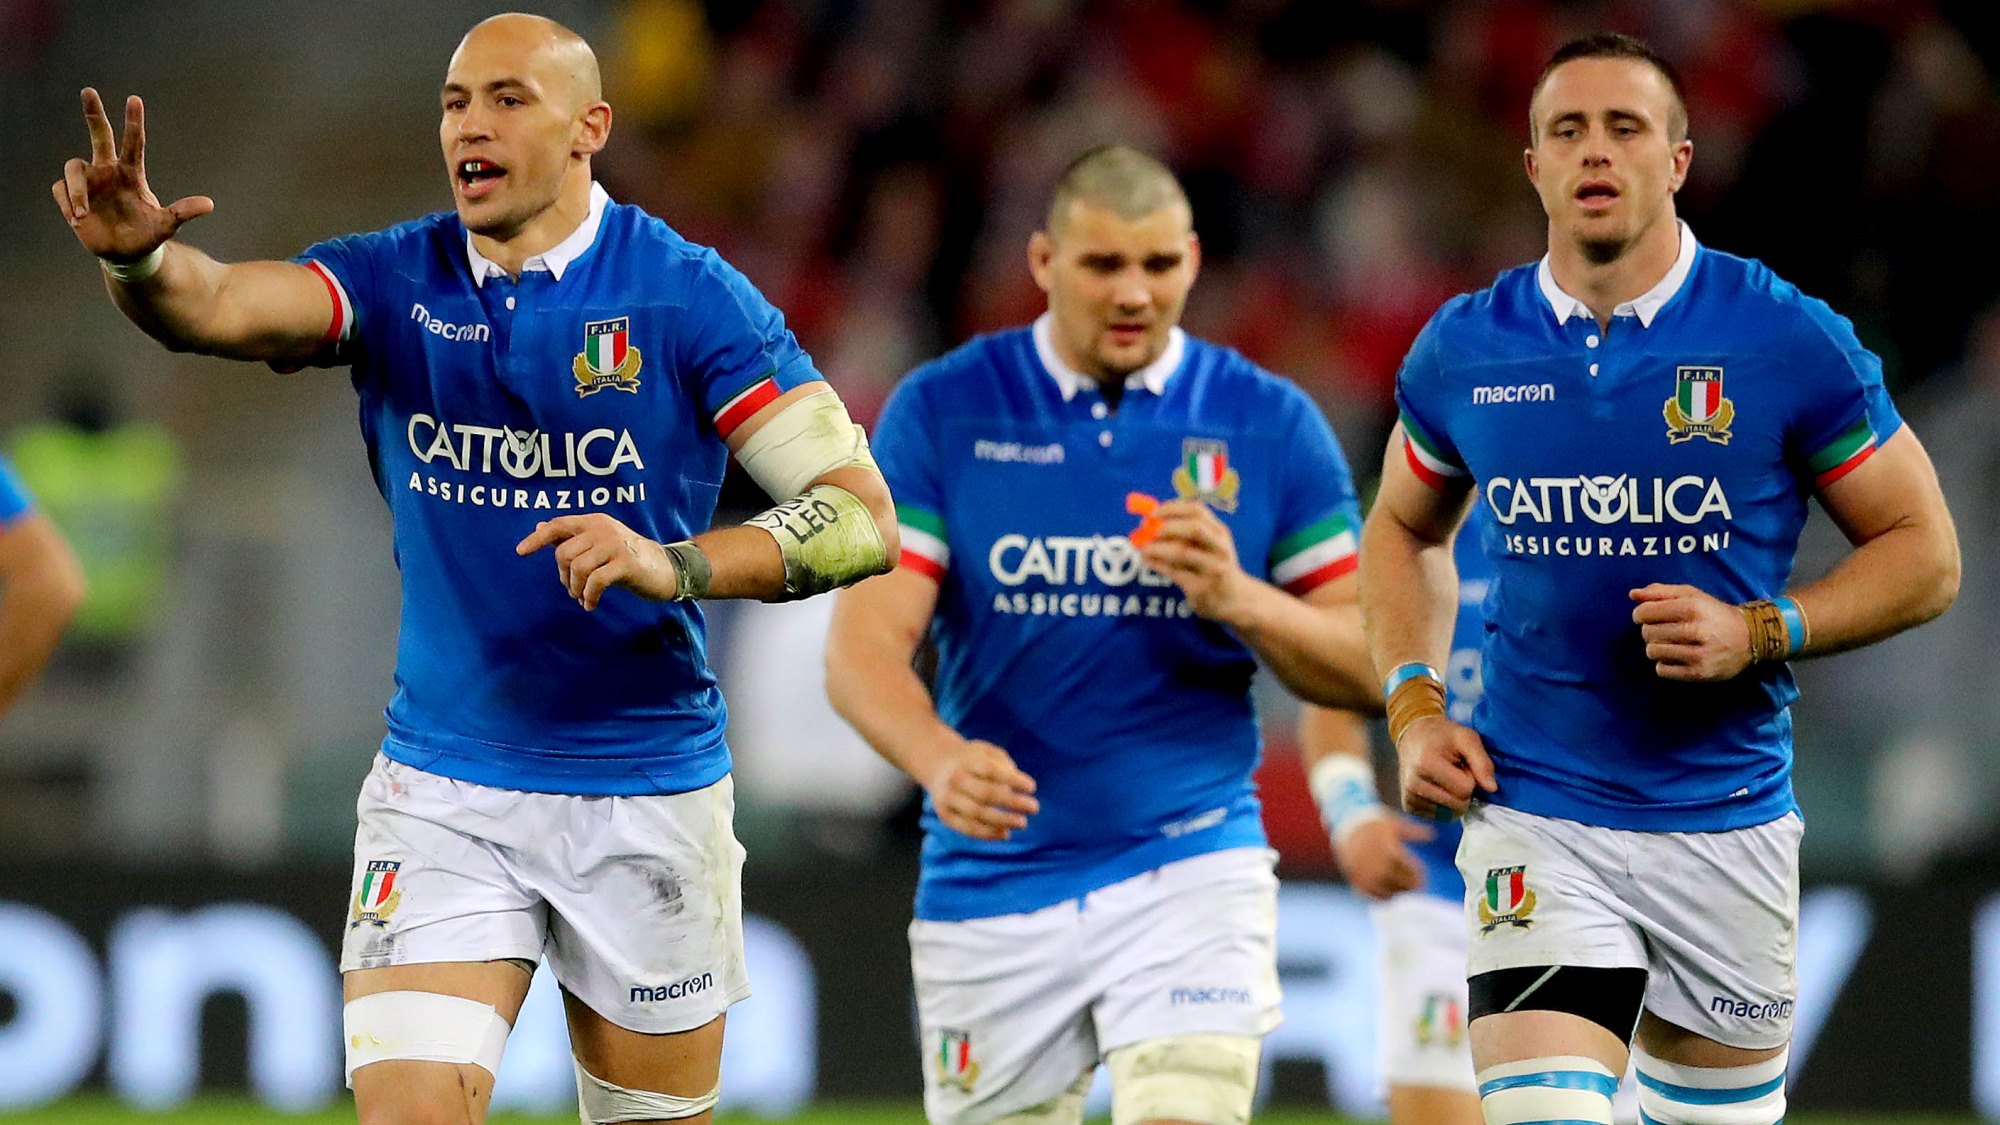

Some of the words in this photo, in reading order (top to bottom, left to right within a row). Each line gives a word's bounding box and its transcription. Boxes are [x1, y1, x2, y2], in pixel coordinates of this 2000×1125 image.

[411, 303, 489, 342] macron
[591, 323, 623, 334] F.I.R.
[594, 376, 620, 384] ITALIA
[1684, 371, 1717, 380] F.I.R.
[1473, 383, 1555, 404] macron
[408, 413, 644, 478] CATTOLICA
[409, 472, 646, 509] ASSICURAZIONI
[1487, 473, 1732, 524] CATTOLICA
[785, 500, 838, 544] LEO
[369, 862, 397, 871] F.I.R.
[630, 972, 713, 1002] macron
